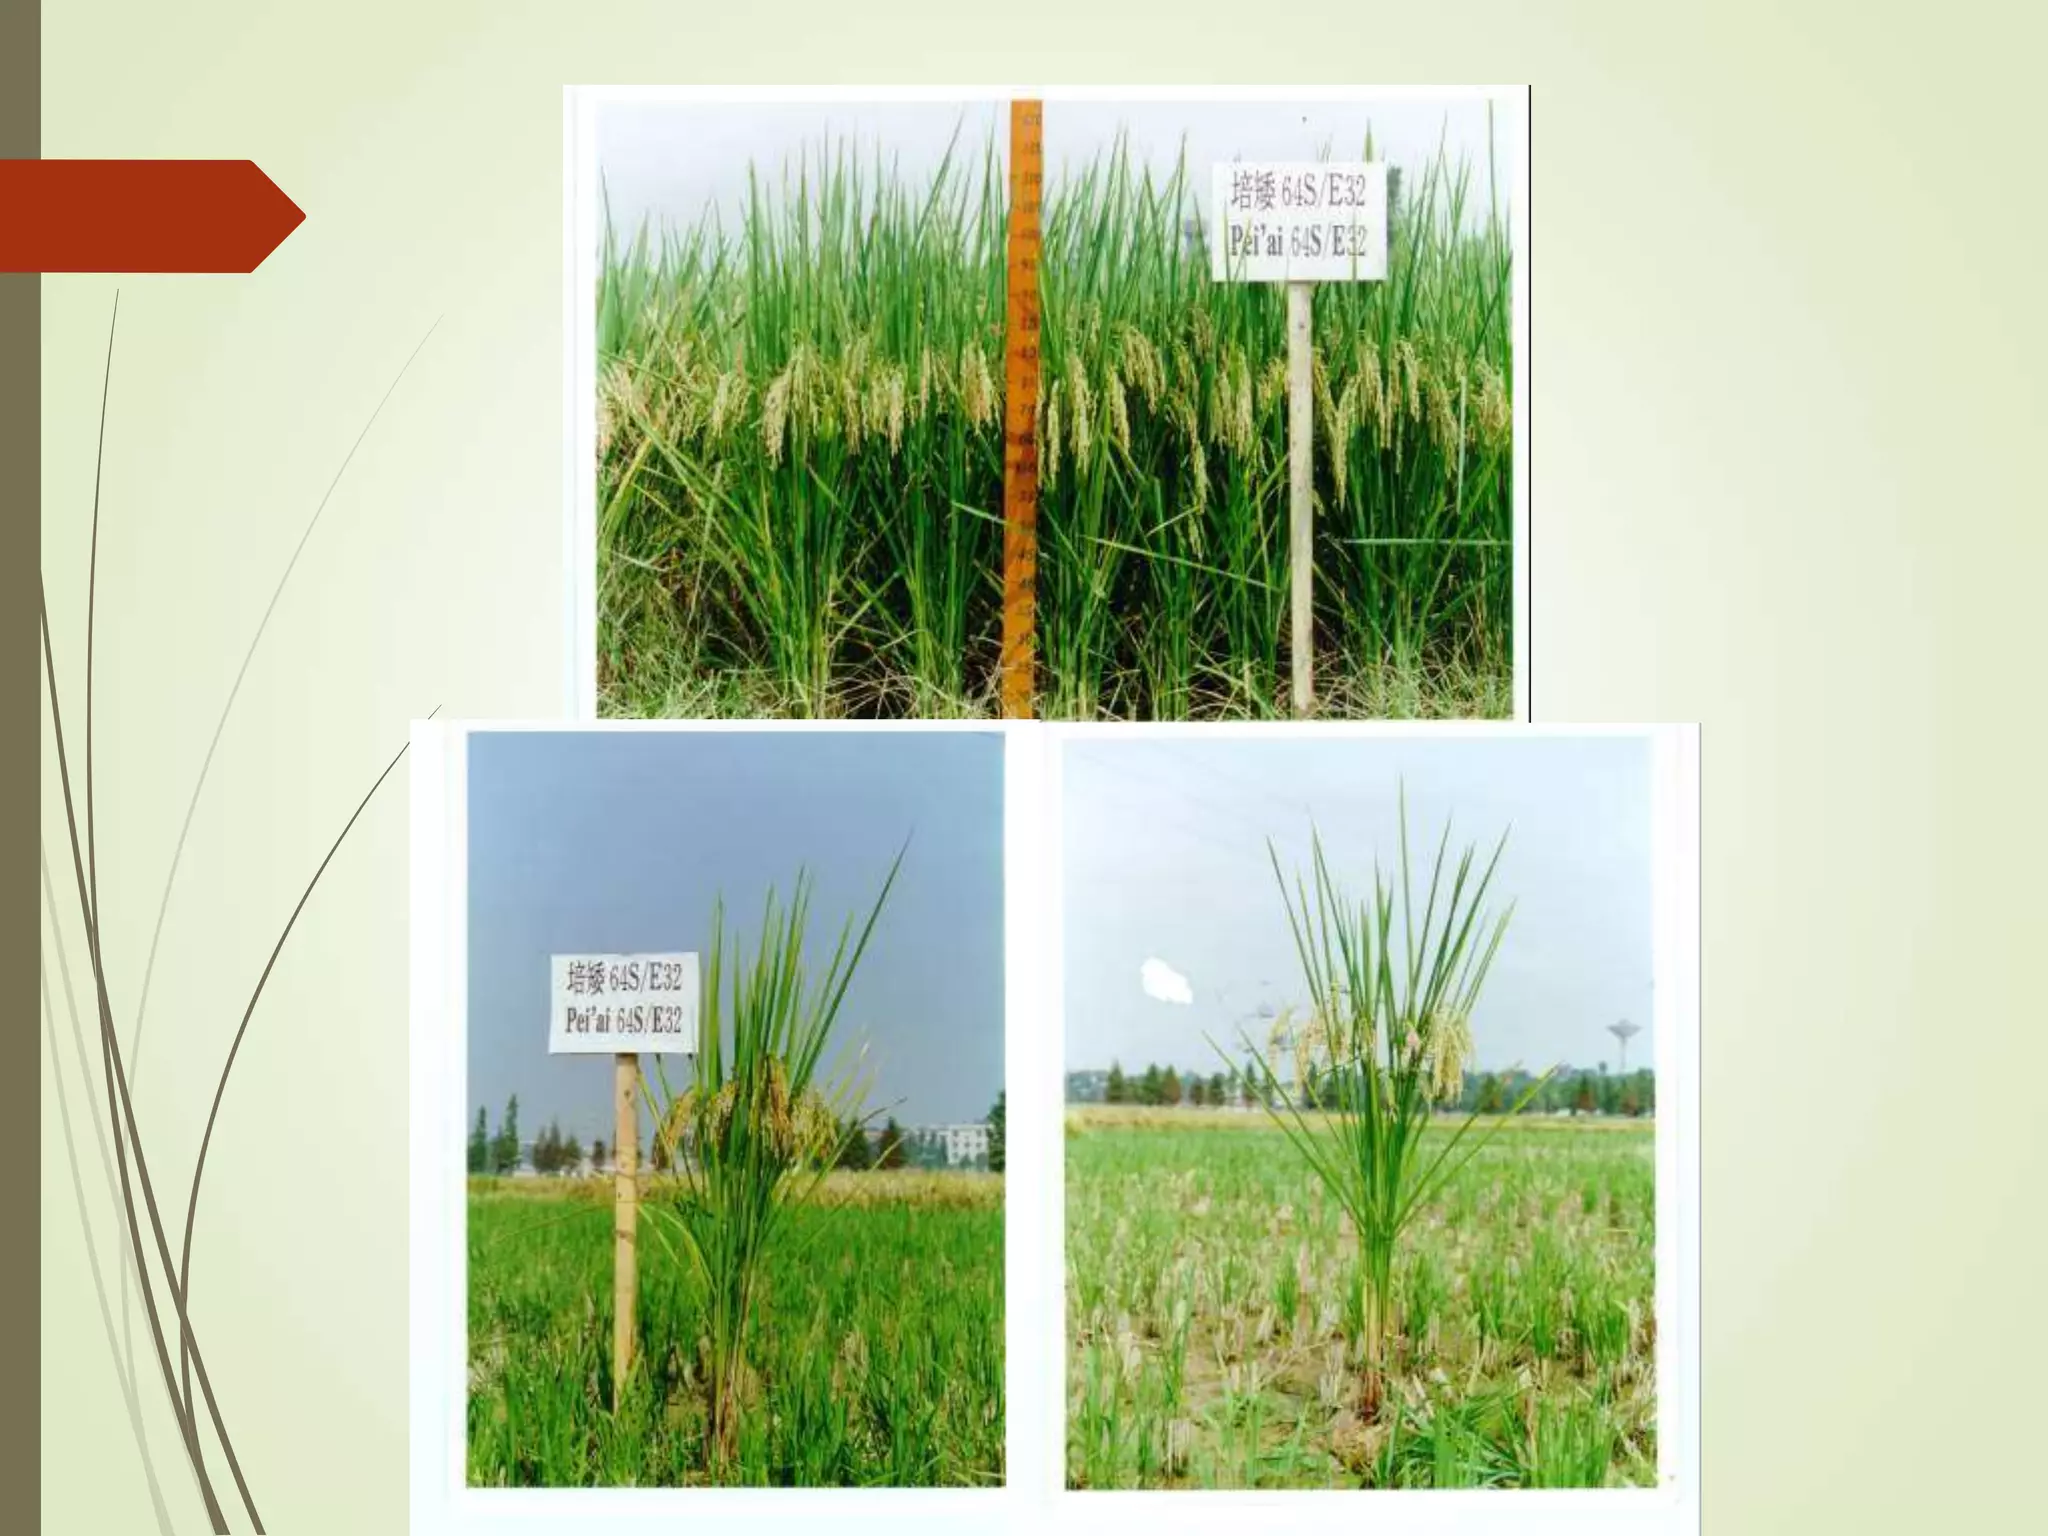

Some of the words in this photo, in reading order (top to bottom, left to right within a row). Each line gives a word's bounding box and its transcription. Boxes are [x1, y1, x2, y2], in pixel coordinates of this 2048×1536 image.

[1282, 172, 1366, 208] 64S/E32
[1291, 222, 1368, 259] 64S/E32
[610, 961, 682, 992] 64S/E32
[565, 1005, 611, 1034] Pei'ai
[616, 1005, 683, 1034] 64S/E32
